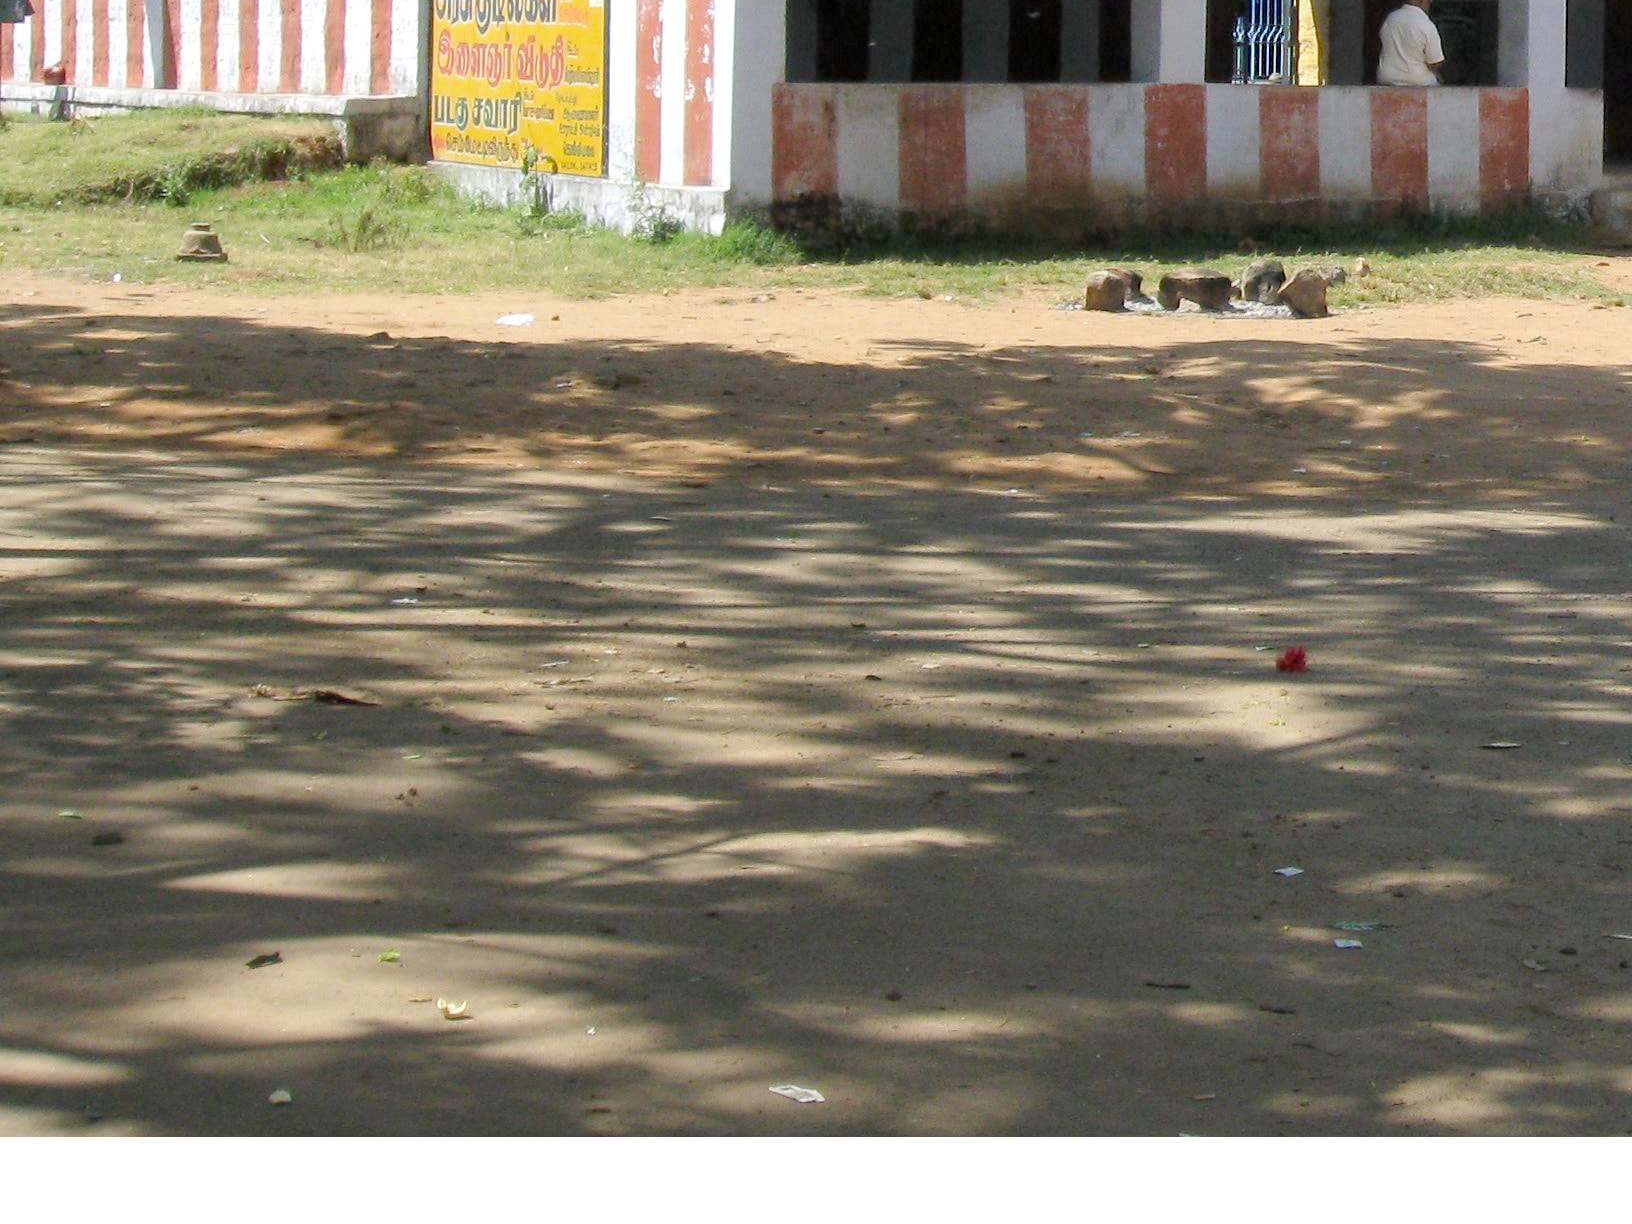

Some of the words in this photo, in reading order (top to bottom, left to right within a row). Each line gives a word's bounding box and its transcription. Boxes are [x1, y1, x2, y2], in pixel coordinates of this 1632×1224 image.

[437, 29, 513, 87] இளைஞர்
[517, 34, 566, 90] விடுதி
[434, 95, 469, 132] படகு
[471, 91, 522, 135] சவாரி
